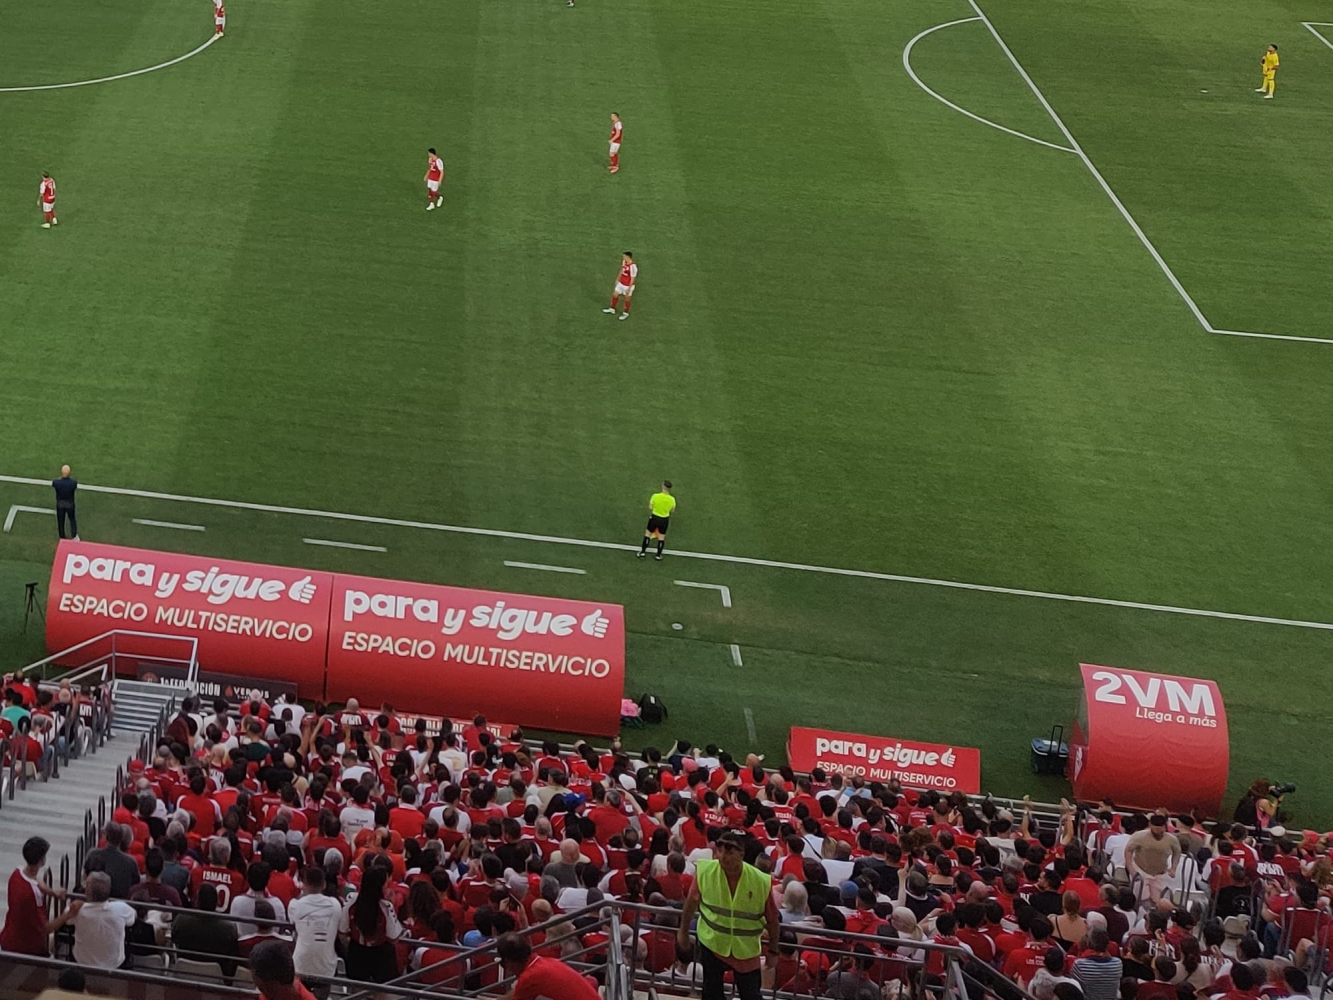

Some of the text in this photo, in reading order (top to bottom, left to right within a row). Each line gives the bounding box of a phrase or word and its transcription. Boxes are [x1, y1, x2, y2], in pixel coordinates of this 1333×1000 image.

[62, 553, 286, 605] para y sigue
[59, 593, 313, 643] ESPACIO MULTISERVICIO
[343, 589, 578, 641] para y sigue
[342, 631, 610, 679] ESPACIO MULTISERVICIO
[1091, 671, 1216, 717] 2VM
[1135, 706, 1218, 729] Llega a más
[816, 737, 940, 768] para y sigue
[816, 761, 957, 788] ESPACIO MULTISERVICIO
[202, 869, 233, 885] ISMAEL
